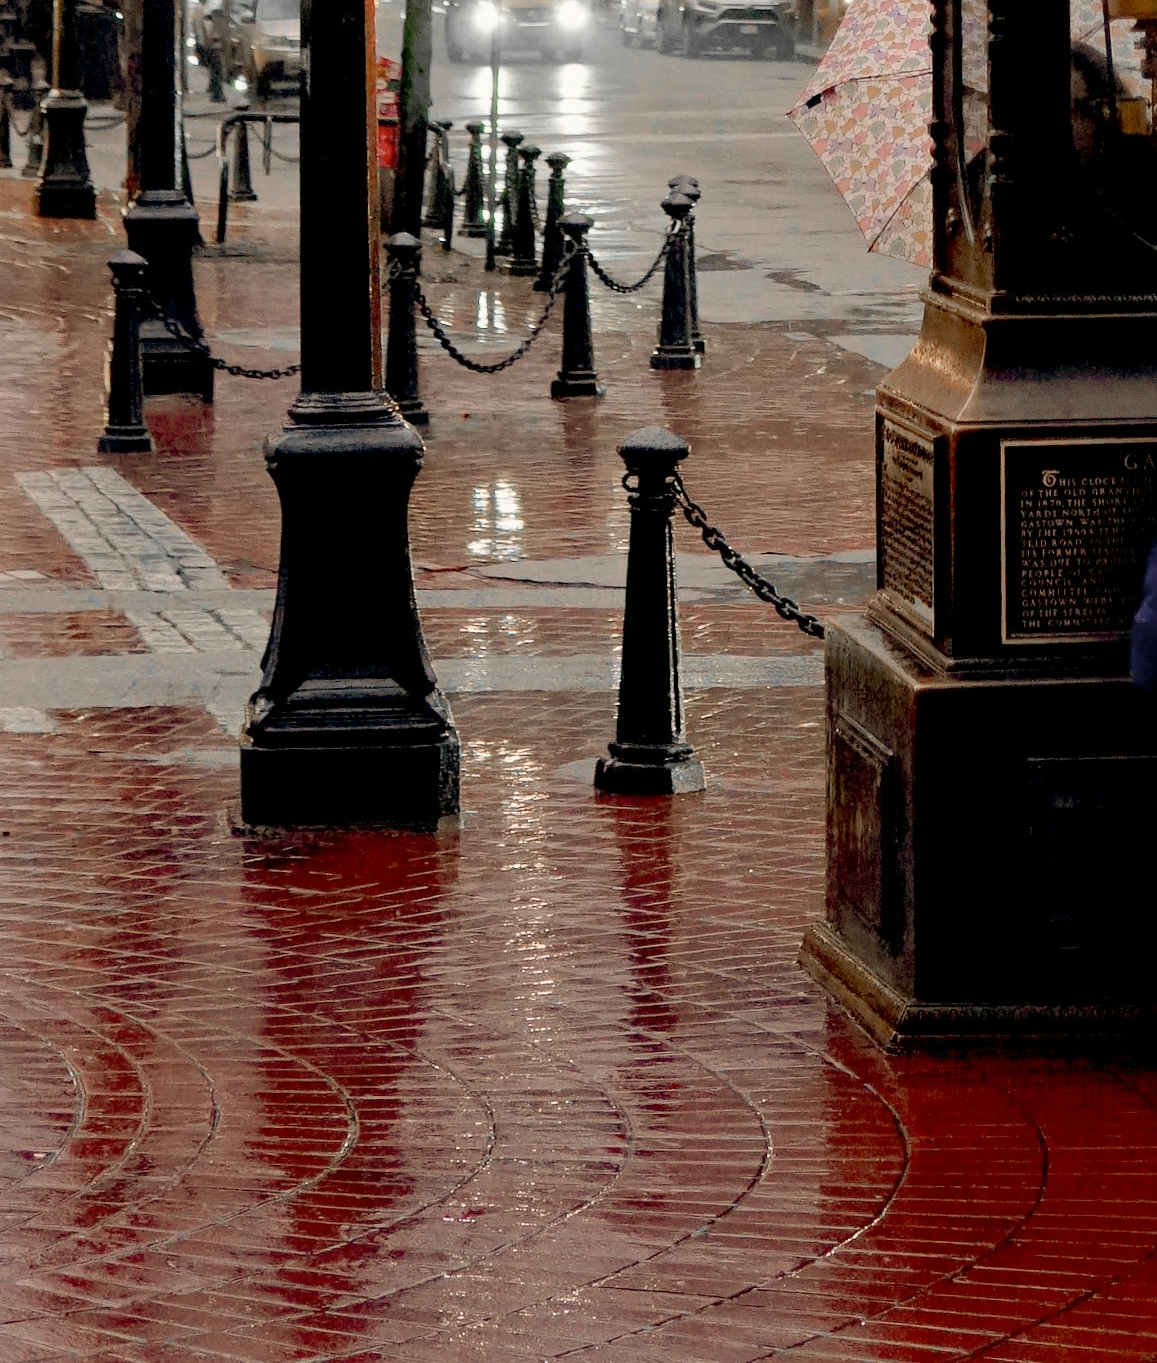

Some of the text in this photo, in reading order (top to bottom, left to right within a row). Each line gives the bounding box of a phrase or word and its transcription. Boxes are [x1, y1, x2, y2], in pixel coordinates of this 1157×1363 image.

[1042, 469, 1077, 487] THIS
[1081, 476, 1117, 486] CLOCK
[1038, 489, 1058, 498] THE
[1064, 488, 1086, 497] OLD
[1067, 498, 1087, 507] THE
[1020, 509, 1057, 518] YARDS
[1062, 508, 1100, 517] NORTH
[1020, 518, 1074, 528] GASTOWN
[1080, 518, 1103, 527] WAS
[1021, 529, 1034, 538] BY
[1038, 528, 1058, 538] THE
[1021, 548, 1037, 558] ITS
[1042, 547, 1087, 557] FORMER
[1021, 559, 1045, 568] WAS
[1049, 558, 1070, 567] DUE
[1021, 569, 1064, 578] PEOPLE
[1020, 578, 1072, 587] COUNCIL
[1021, 597, 1077, 608] GASTOWN
[1039, 608, 1058, 617] THE
[1022, 619, 1041, 628] THE
